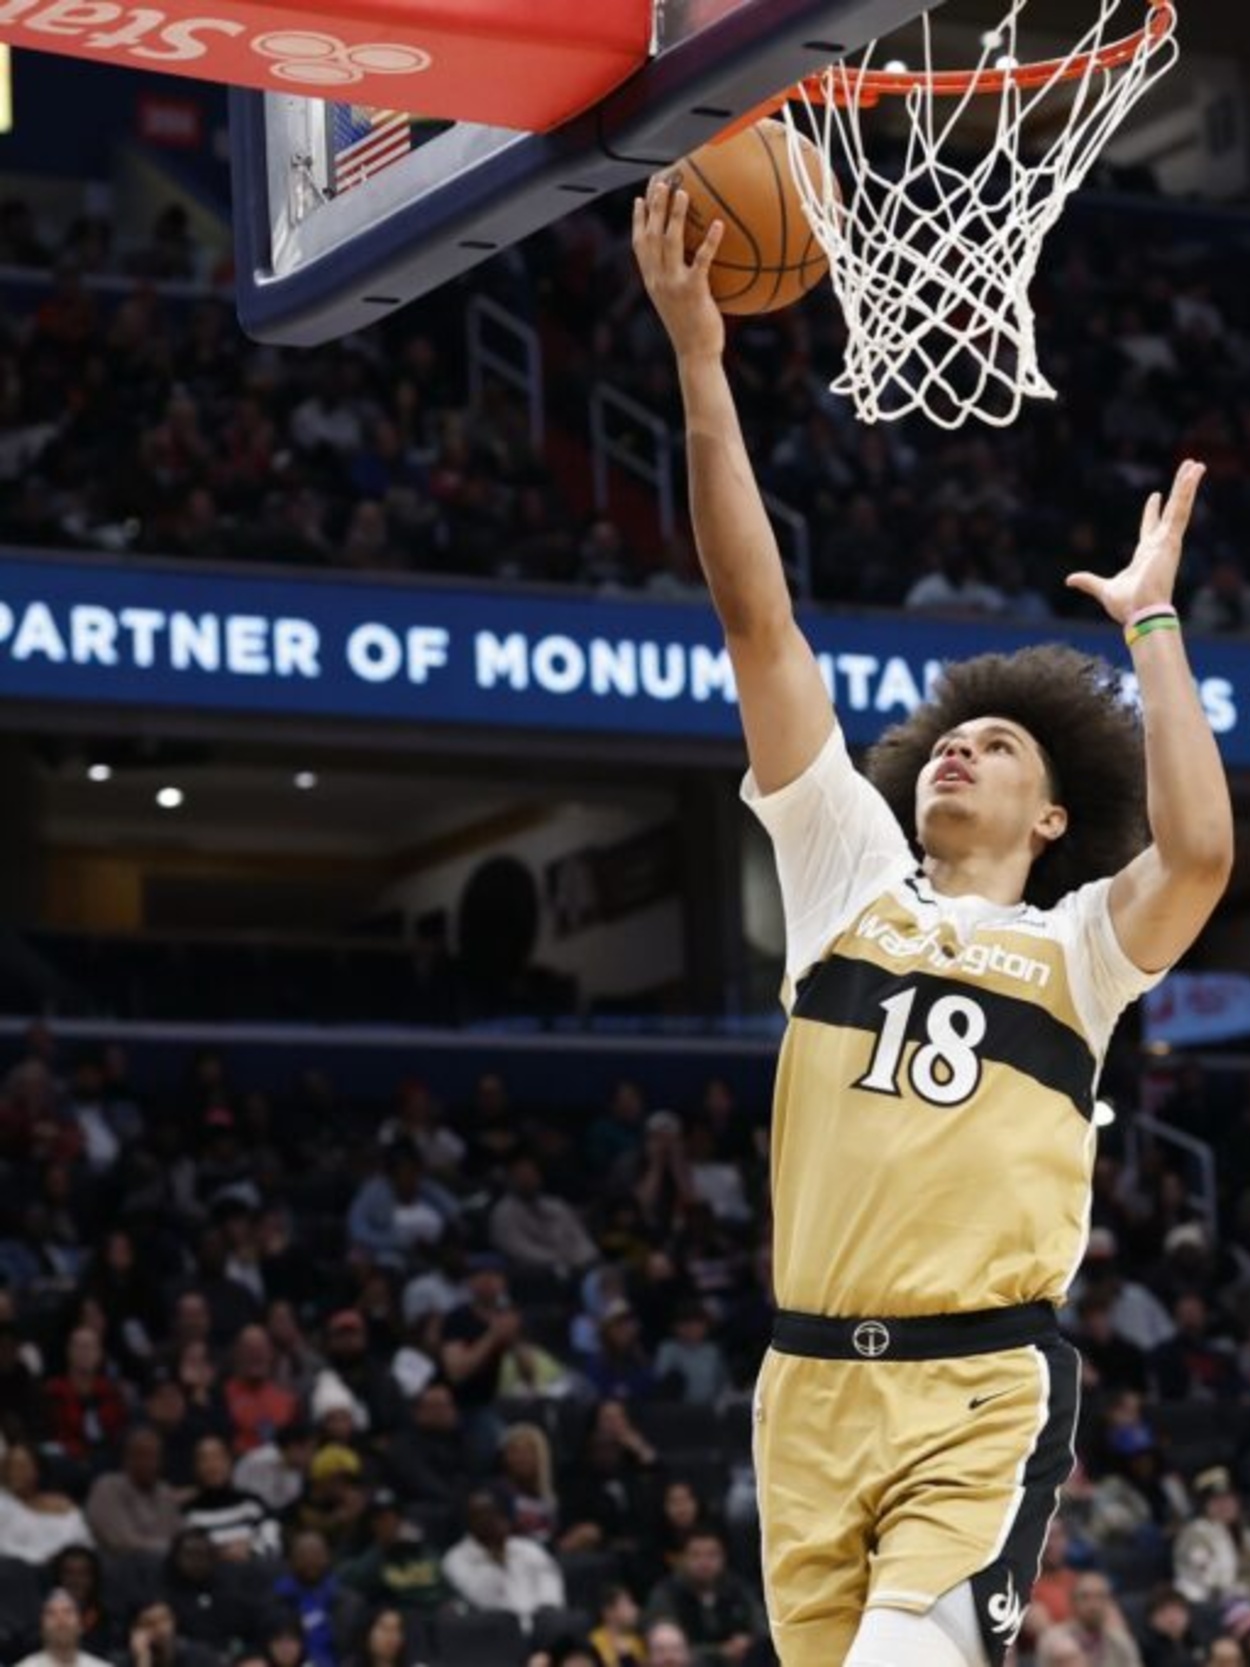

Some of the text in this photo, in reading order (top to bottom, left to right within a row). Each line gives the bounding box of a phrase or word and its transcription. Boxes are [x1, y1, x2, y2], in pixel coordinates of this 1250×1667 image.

[0, 601, 945, 716] ARTNER OF MONUMTA
[850, 986, 987, 1108] 18
